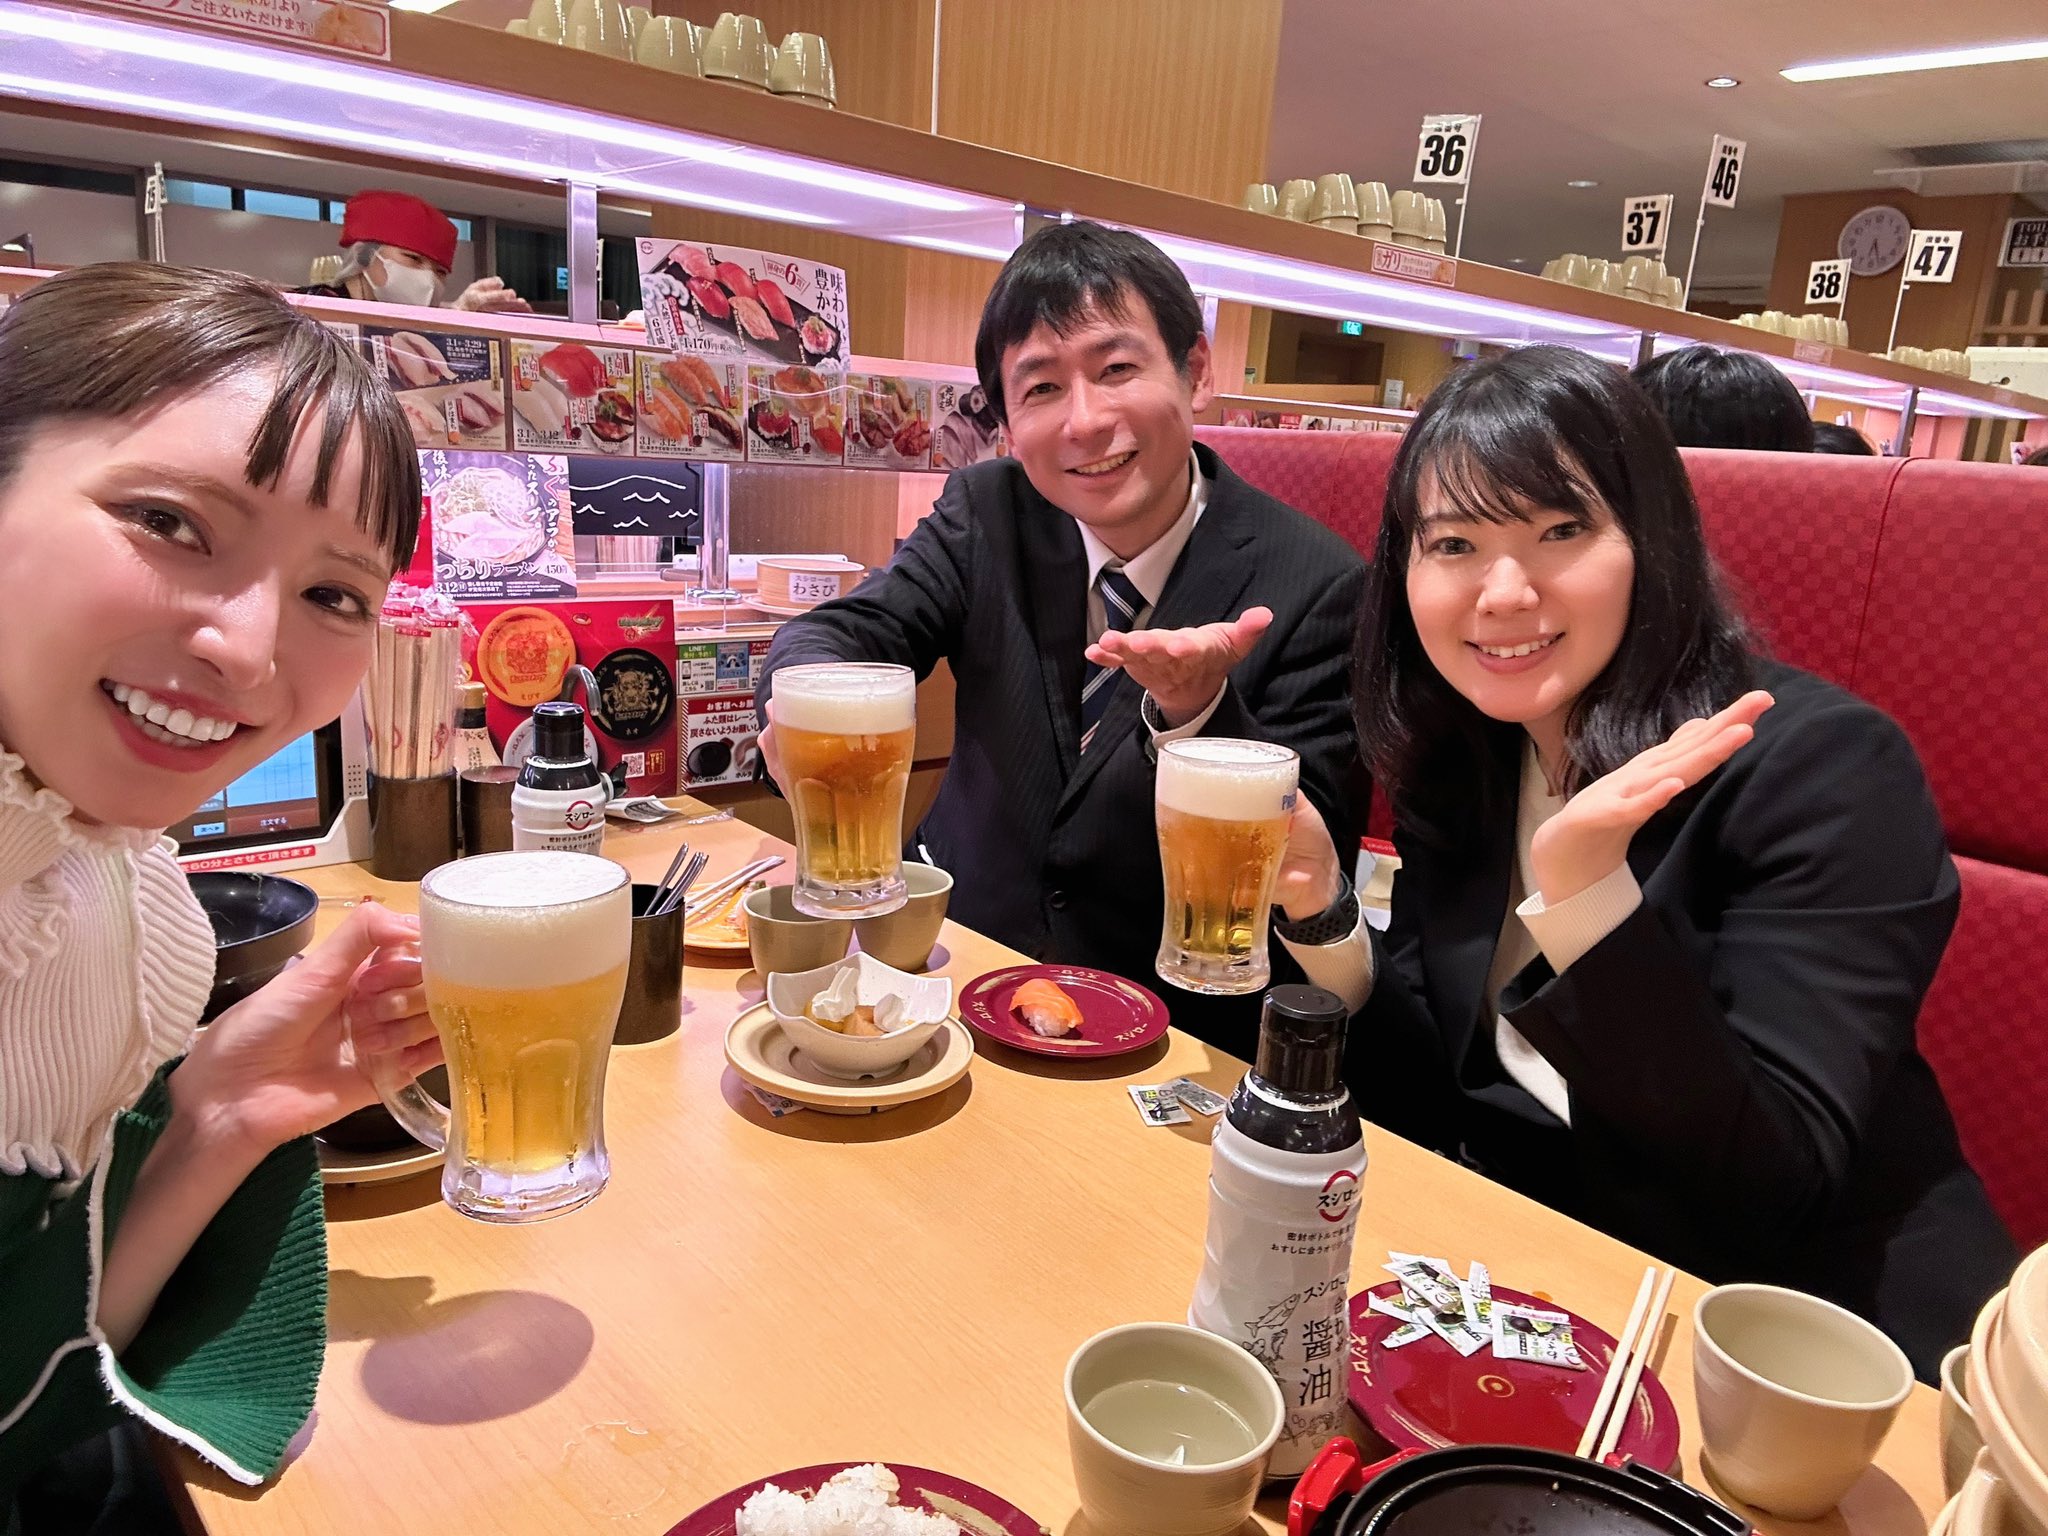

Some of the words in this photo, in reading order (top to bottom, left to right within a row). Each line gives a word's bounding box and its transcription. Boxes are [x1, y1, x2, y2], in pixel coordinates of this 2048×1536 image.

[1420, 134, 1467, 176] 36
[1711, 157, 1739, 200] 46
[1626, 210, 1661, 245] 37
[1913, 246, 1954, 277] 47
[815, 268, 832, 321] 豊か。
[1810, 271, 1841, 300] 38
[830, 273, 847, 342] 味わい、
[793, 582, 836, 597] わさび
[565, 811, 595, 822] スシロー
[1113, 1023, 1149, 1043] スシロー
[1316, 1188, 1359, 1209] スシロー
[1303, 1277, 1346, 1304] スシロー
[1299, 1316, 1333, 1407] 醤油
